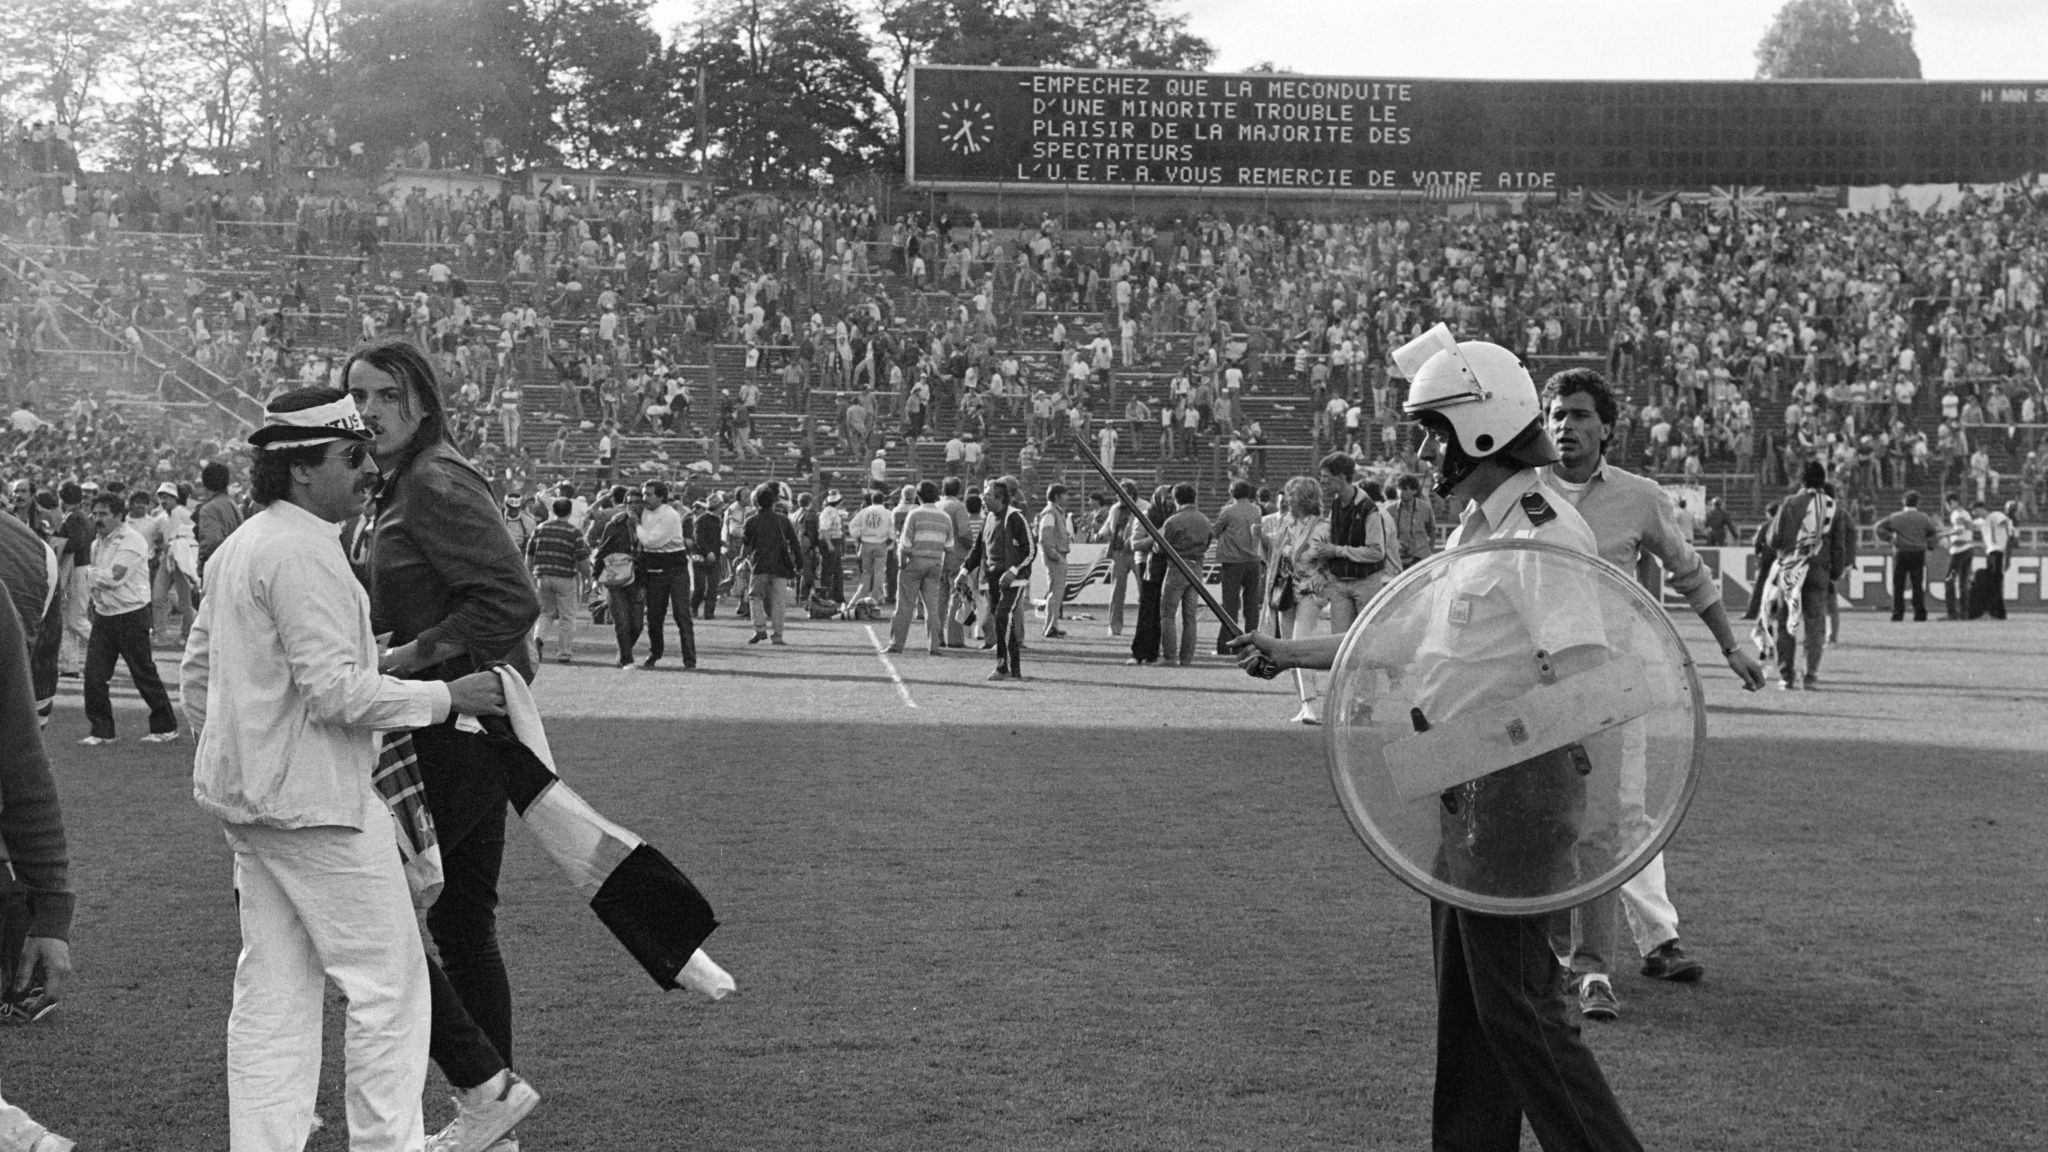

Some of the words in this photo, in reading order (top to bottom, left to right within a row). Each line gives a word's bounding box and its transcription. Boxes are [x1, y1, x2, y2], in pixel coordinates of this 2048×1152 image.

[1166, 79, 1209, 97] QUE
[1224, 80, 1253, 98] LA
[1268, 81, 1412, 102] MECONDUITE
[1981, 88, 1993, 103] H
[2001, 88, 2028, 103] MIN
[1033, 98, 1105, 116] D'UNE
[1121, 100, 1238, 119] MINORITE
[1254, 103, 1354, 122] TROUBLE
[1369, 105, 1398, 123] LE
[1033, 120, 1135, 138] PLAISIR
[1151, 122, 1179, 139] DE
[1195, 123, 1223, 141] LA
[1238, 125, 1354, 144] MAJORITE
[1369, 127, 1412, 145] DES
[1033, 143, 1193, 161] SPECTATEURS
[1238, 168, 1353, 187] REMERCIE
[1368, 170, 1397, 187] DE
[1412, 171, 1483, 189] VOTRE
[1498, 172, 1557, 189] AIDE
[325, 414, 360, 430] TUS
